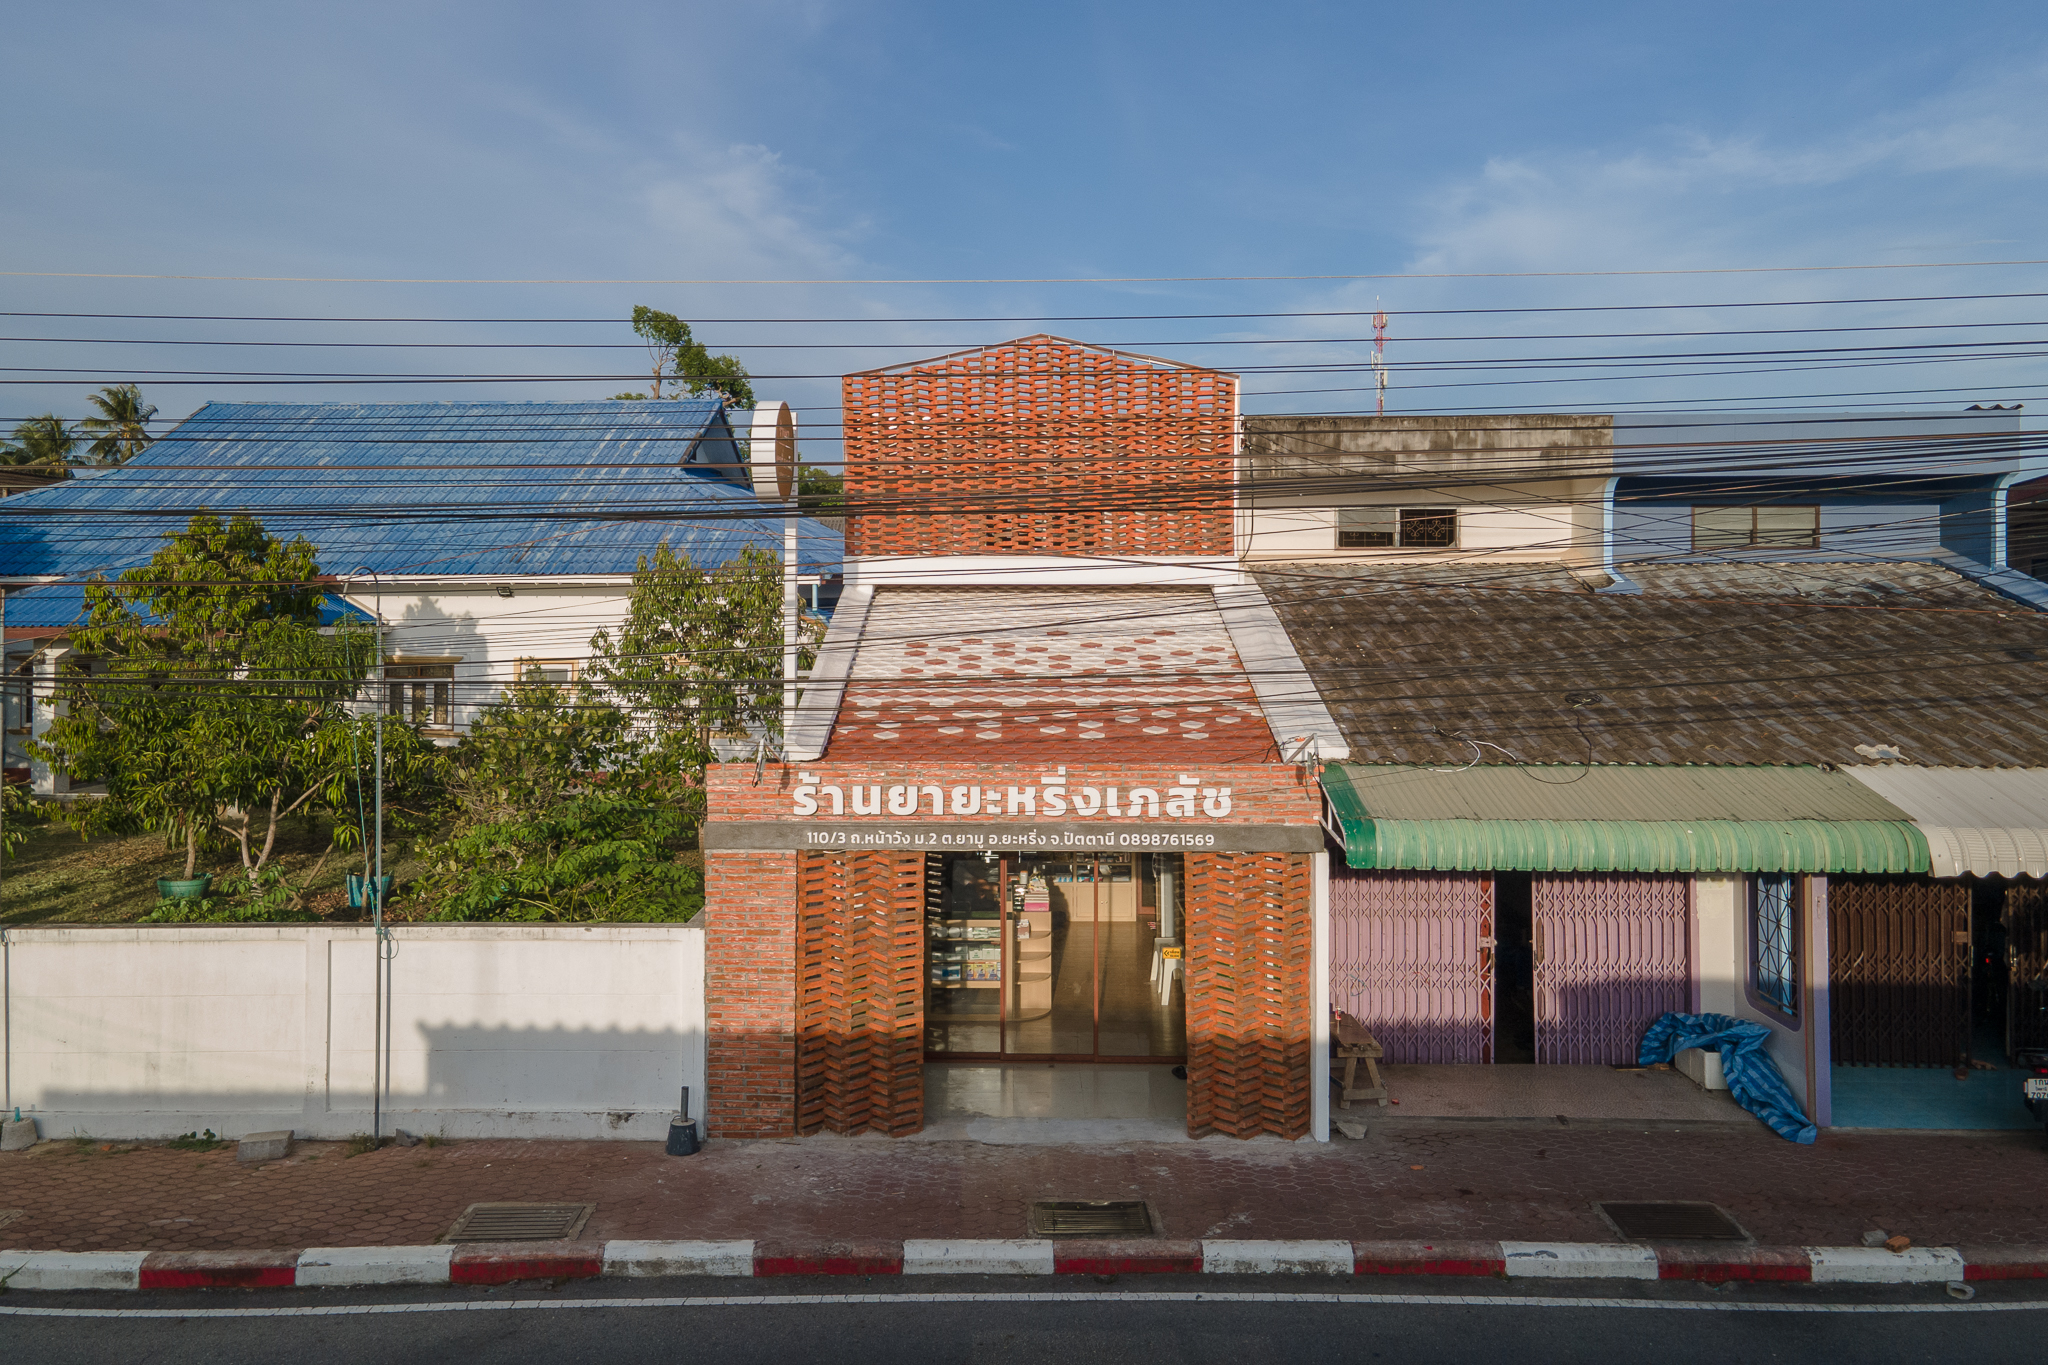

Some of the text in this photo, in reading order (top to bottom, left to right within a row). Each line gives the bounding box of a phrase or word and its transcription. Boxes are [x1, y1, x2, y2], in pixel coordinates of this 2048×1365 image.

[793, 766, 1232, 816] ร้านยายะหริ่งเภสัช
[806, 829, 1215, 849] 110/3 ถ.หน้าวัง ม.2 ต.ยามู อ.ยะหริ่ง จ.ปัตตานี 0898761569
